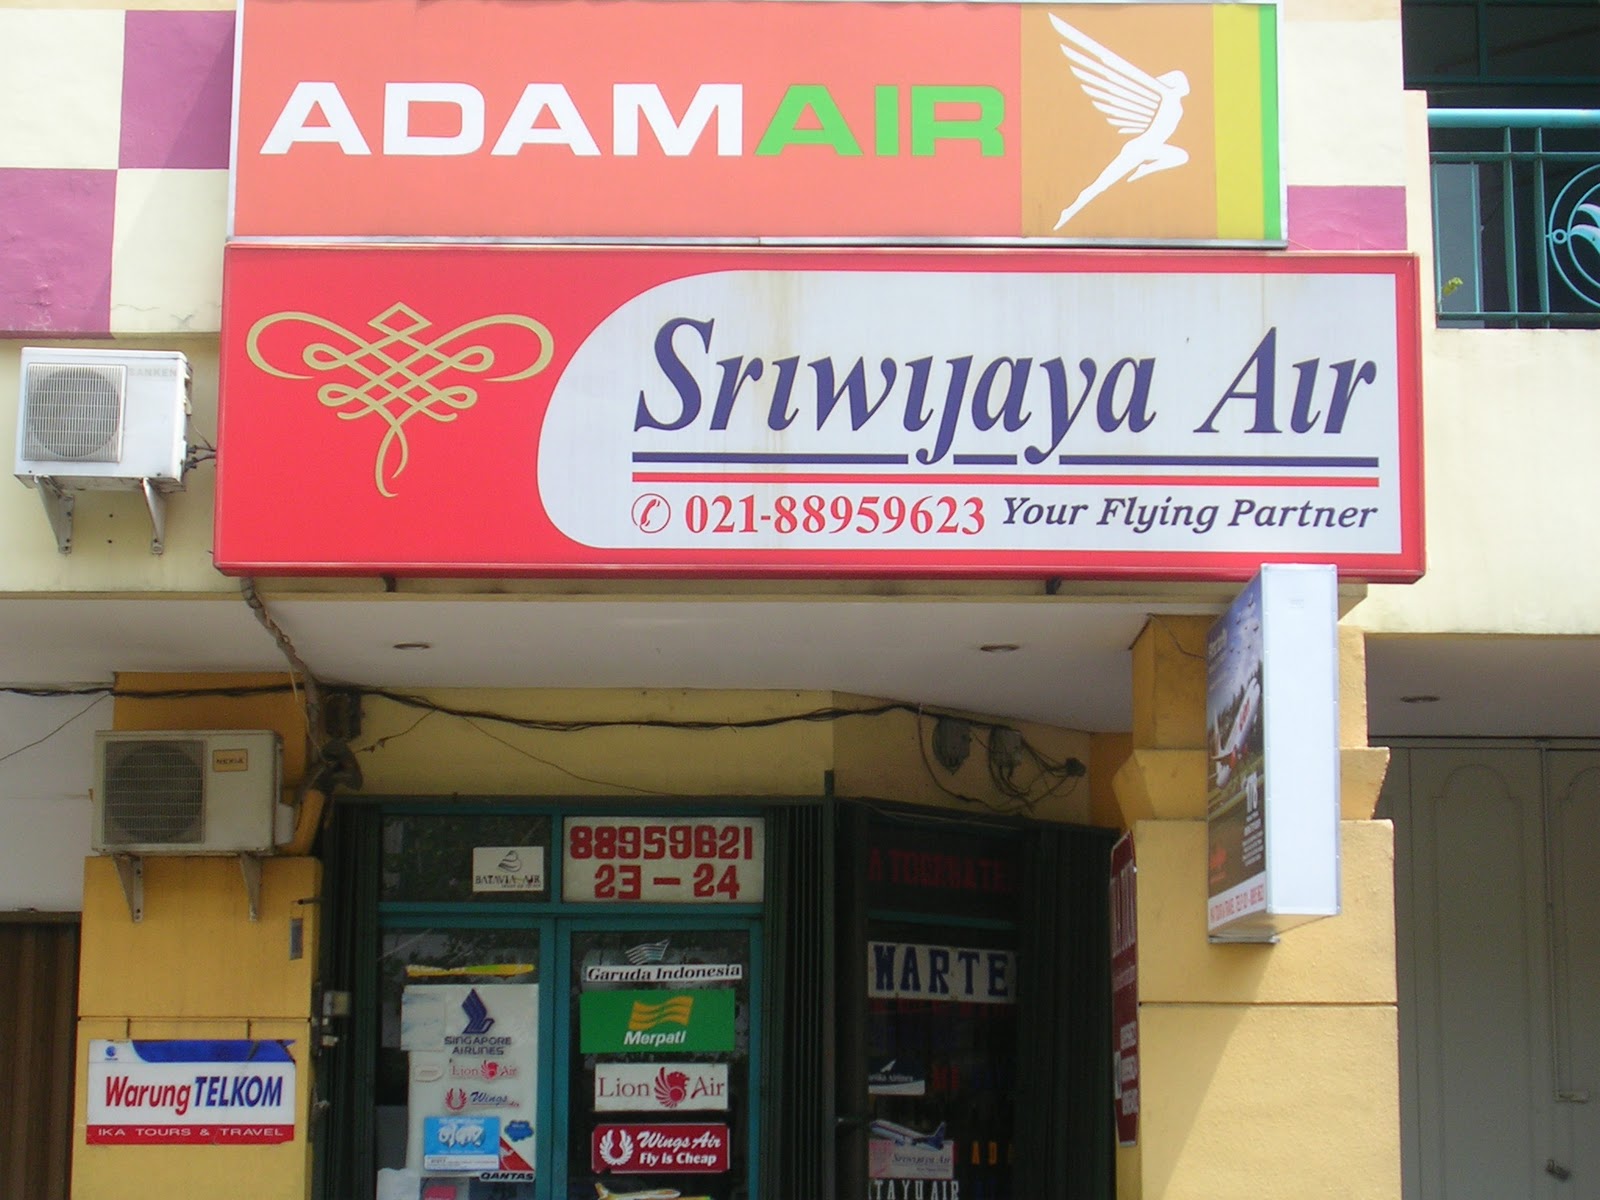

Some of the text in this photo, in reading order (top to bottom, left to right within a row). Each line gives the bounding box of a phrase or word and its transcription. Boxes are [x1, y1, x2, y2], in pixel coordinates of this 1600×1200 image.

[128, 367, 177, 377] SANKEN
[633, 316, 1377, 465] Sriwijaya Air
[684, 494, 986, 536] 021-88959623
[1003, 496, 1378, 534] Your Flying Partner
[569, 825, 753, 861] 88959621
[475, 874, 516, 885] BATAVIA
[594, 864, 641, 899] 23
[693, 863, 740, 899] 24
[588, 963, 741, 981] Garuda Indonesia
[444, 1035, 513, 1046] SINGAPORE
[623, 1030, 688, 1048] Merpati
[452, 1045, 505, 1056] AIRLINES
[452, 1064, 518, 1077] Lion Air
[598, 1076, 725, 1099] Lion Air
[470, 1090, 508, 1106] Wings
[98, 1127, 285, 1137] IKA TOURS & TRAVEL
[637, 1130, 722, 1152] Wings Air
[639, 1151, 660, 1167] Fly
[676, 1151, 718, 1167] Cheap
[480, 1171, 535, 1181] QANTAS
[869, 1179, 960, 1200] TAYU AIR
